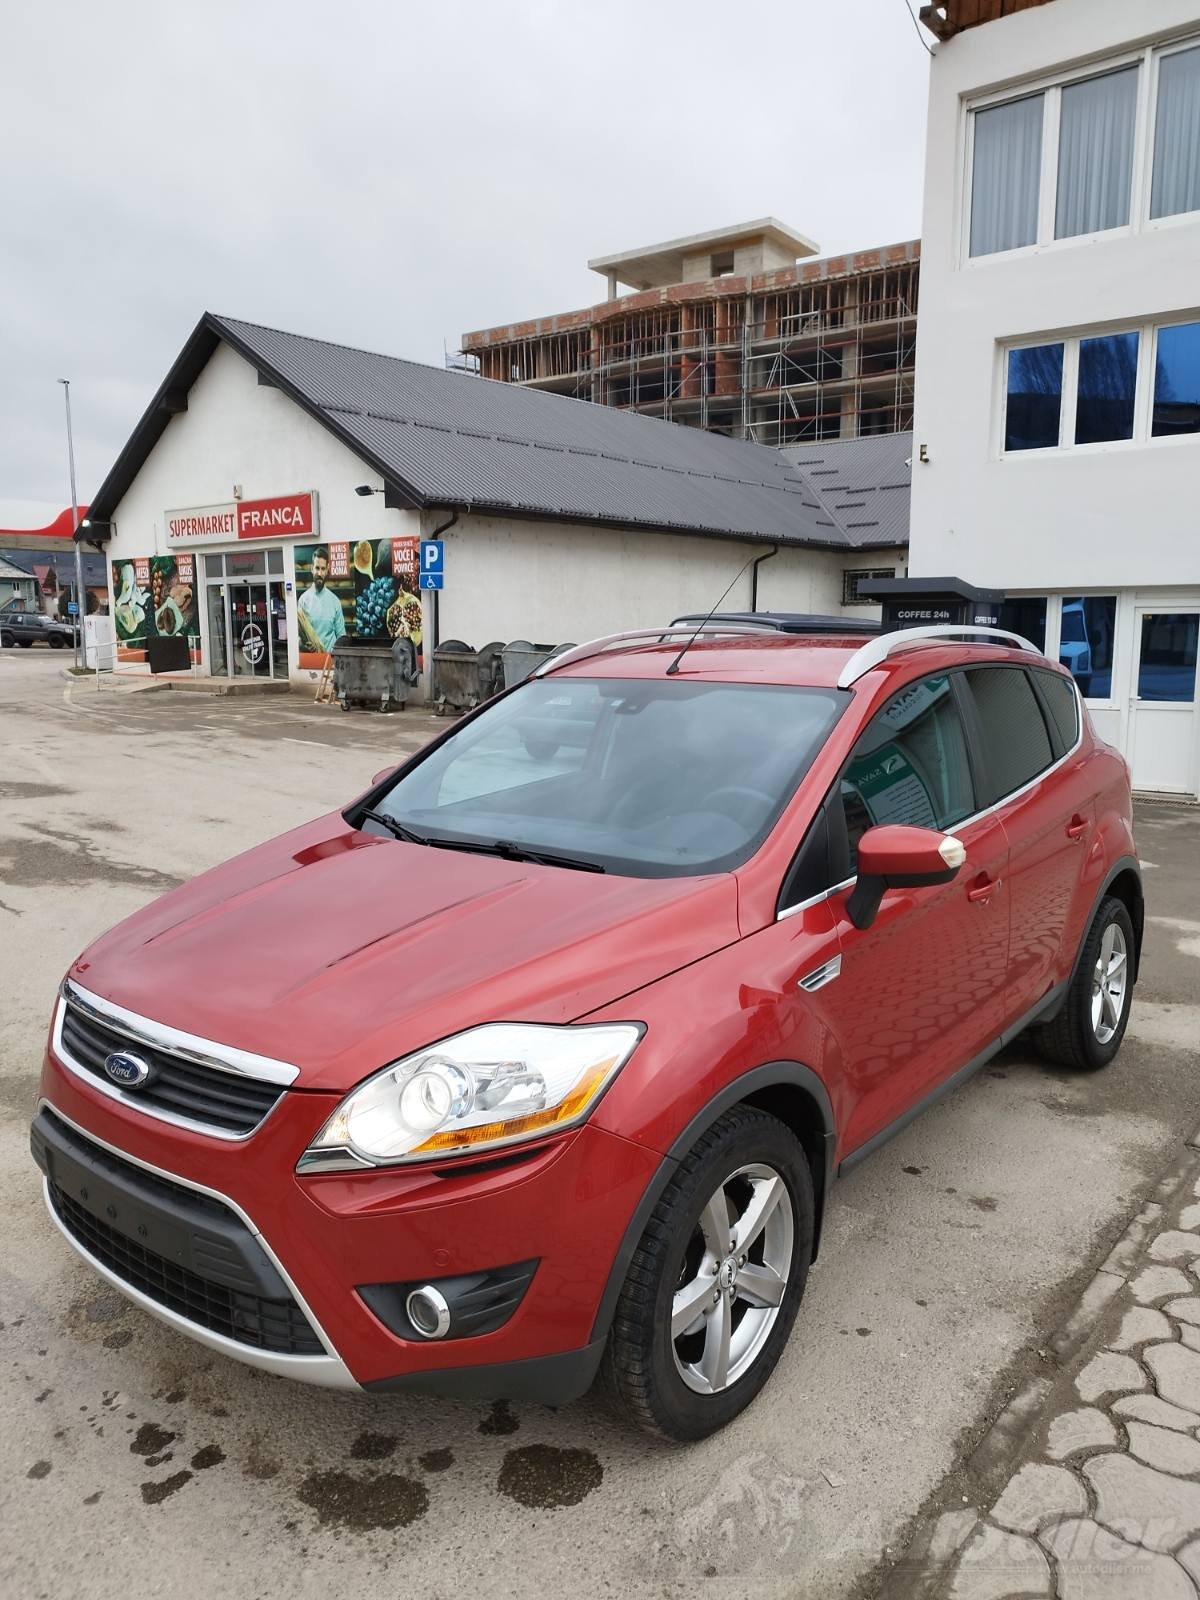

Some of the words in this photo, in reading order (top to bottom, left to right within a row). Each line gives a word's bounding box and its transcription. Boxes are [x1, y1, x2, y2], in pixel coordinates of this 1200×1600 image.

[169, 513, 235, 538] SUPERMARKET
[240, 506, 304, 532] FRANCA
[393, 548, 410, 561] VOĆE
[425, 545, 439, 569] P
[898, 610, 931, 618] COFFEE
[933, 610, 950, 619] 24h
[110, 1058, 132, 1078] Ford
